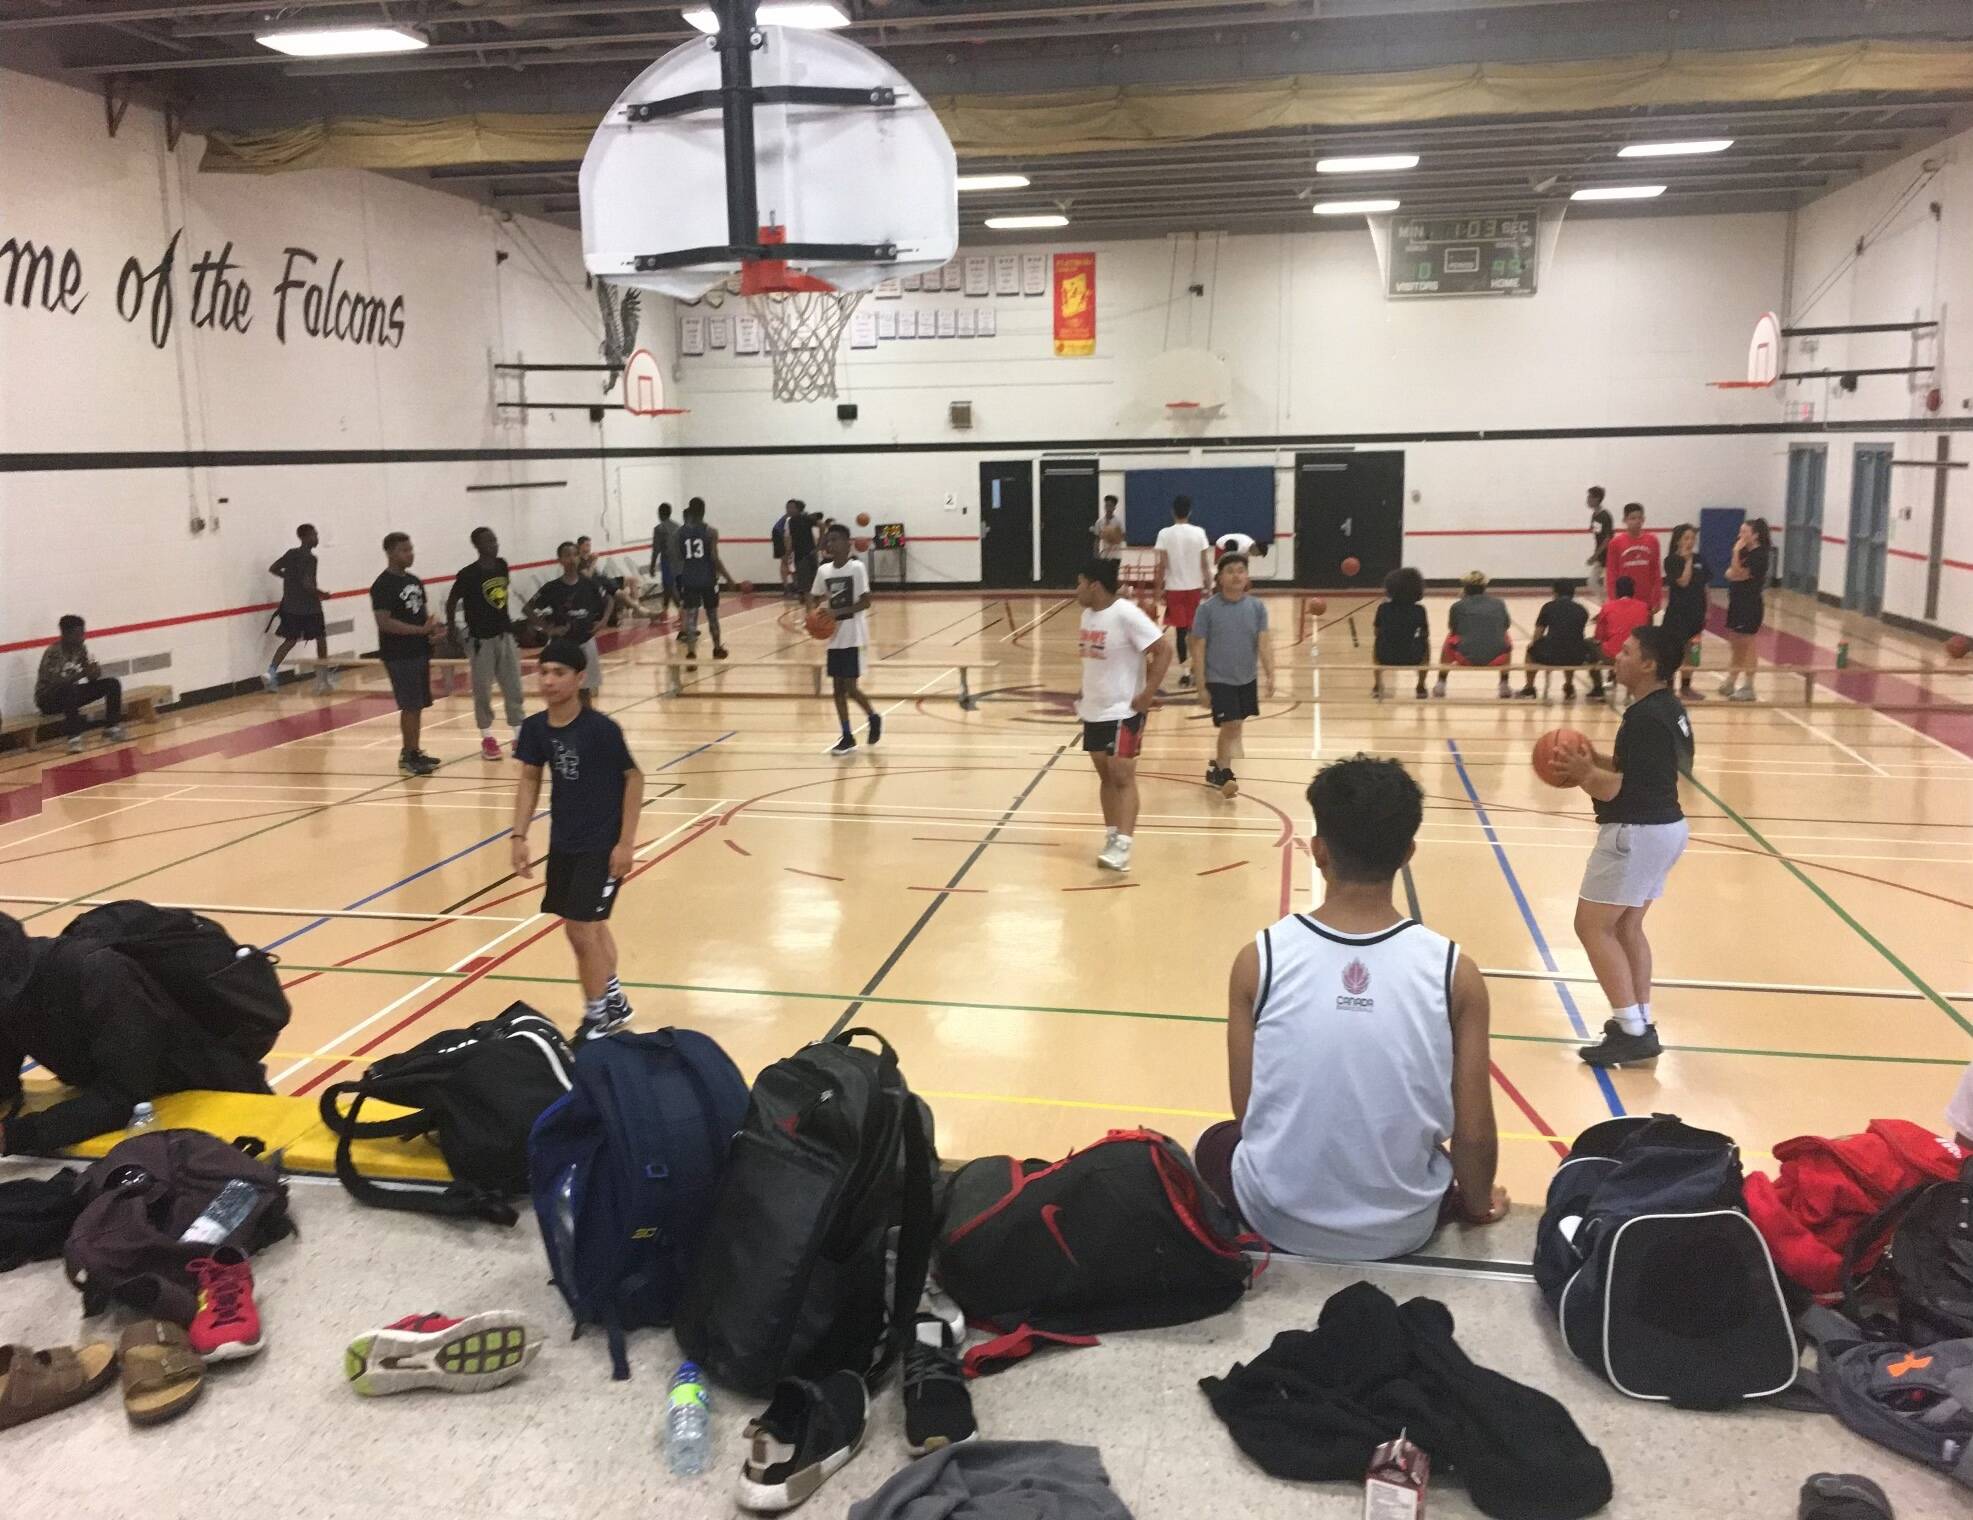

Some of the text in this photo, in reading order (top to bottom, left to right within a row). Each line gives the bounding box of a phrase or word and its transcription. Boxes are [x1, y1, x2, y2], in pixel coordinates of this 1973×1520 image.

[1502, 220, 1529, 233] SEC
[117, 225, 184, 349] of
[191, 241, 253, 334] the
[273, 247, 405, 348] Falcons
[684, 538, 704, 559] 13
